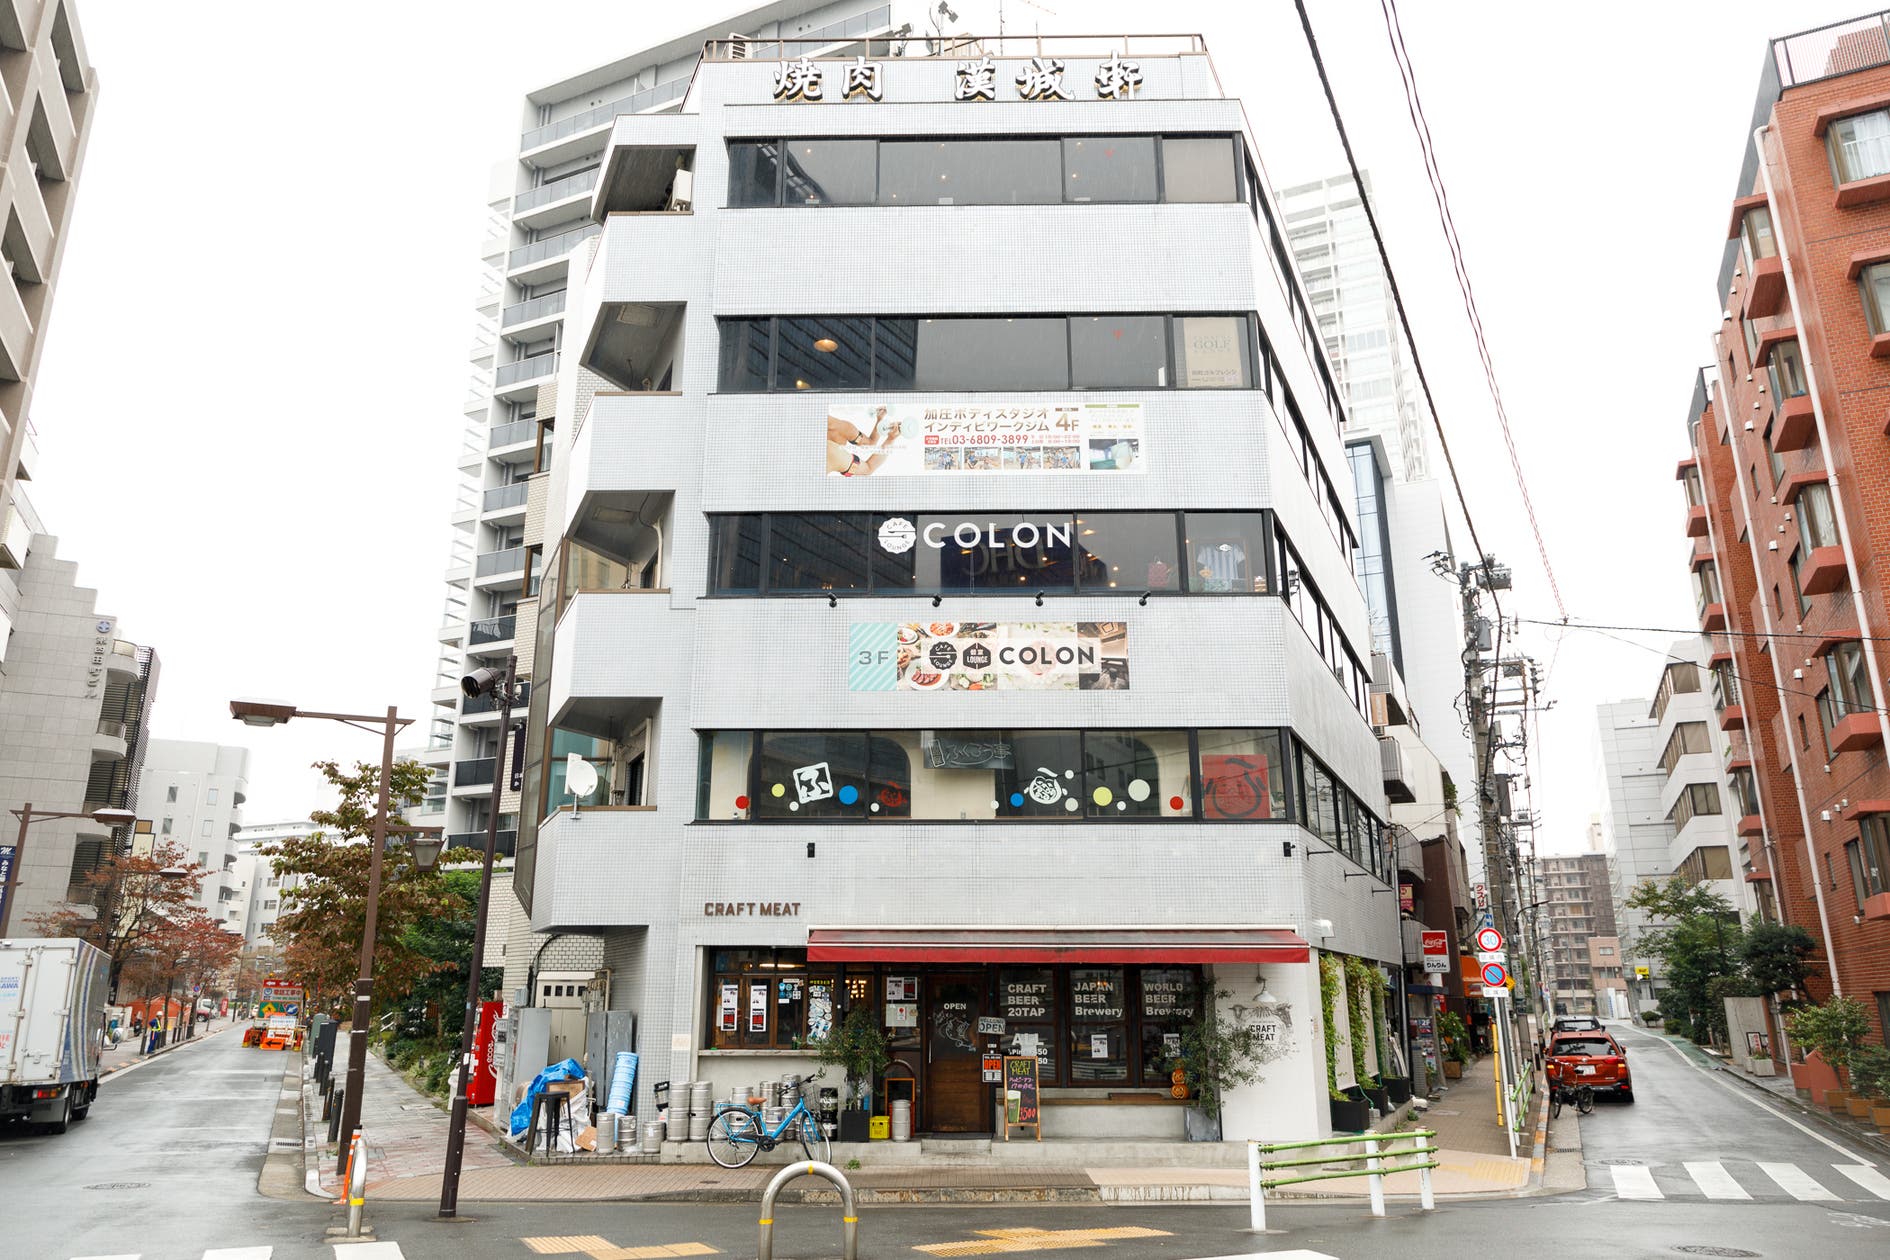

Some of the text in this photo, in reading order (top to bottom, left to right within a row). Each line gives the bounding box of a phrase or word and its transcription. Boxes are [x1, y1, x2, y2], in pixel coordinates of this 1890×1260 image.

[773, 49, 1143, 102] 焼肉 漢城軒
[924, 408, 1048, 420] 加圧ボディスタジオ
[1055, 413, 1080, 432] 4F
[940, 436, 951, 445] TEL
[952, 434, 1029, 445] 03-6809-3899
[923, 522, 1071, 549] COLON
[858, 651, 889, 665] 3F
[999, 646, 1094, 665] COLON
[1475, 884, 1485, 908] クスリ
[705, 902, 801, 917] CRAFT MEAT
[1483, 934, 1498, 946] 30
[1007, 984, 1047, 993] CRAFT
[1074, 982, 1114, 992] JAPAN
[1144, 983, 1184, 992] WORLD
[1007, 996, 1040, 1005] BEER
[1074, 994, 1106, 1003] BEER
[1146, 995, 1176, 1004] BEER
[1007, 1007, 1046, 1017] 20TAP
[1075, 1006, 1123, 1018] Brewery
[1146, 1006, 1194, 1018] Brewery
[979, 1022, 1005, 1033] OPEN
[1249, 1024, 1277, 1033] CRAFT
[1252, 1033, 1275, 1041] MEAT
[984, 1060, 1001, 1070] OPEN
[1010, 1060, 1032, 1069] CRAFT
[1011, 1068, 1031, 1076] MEAT
